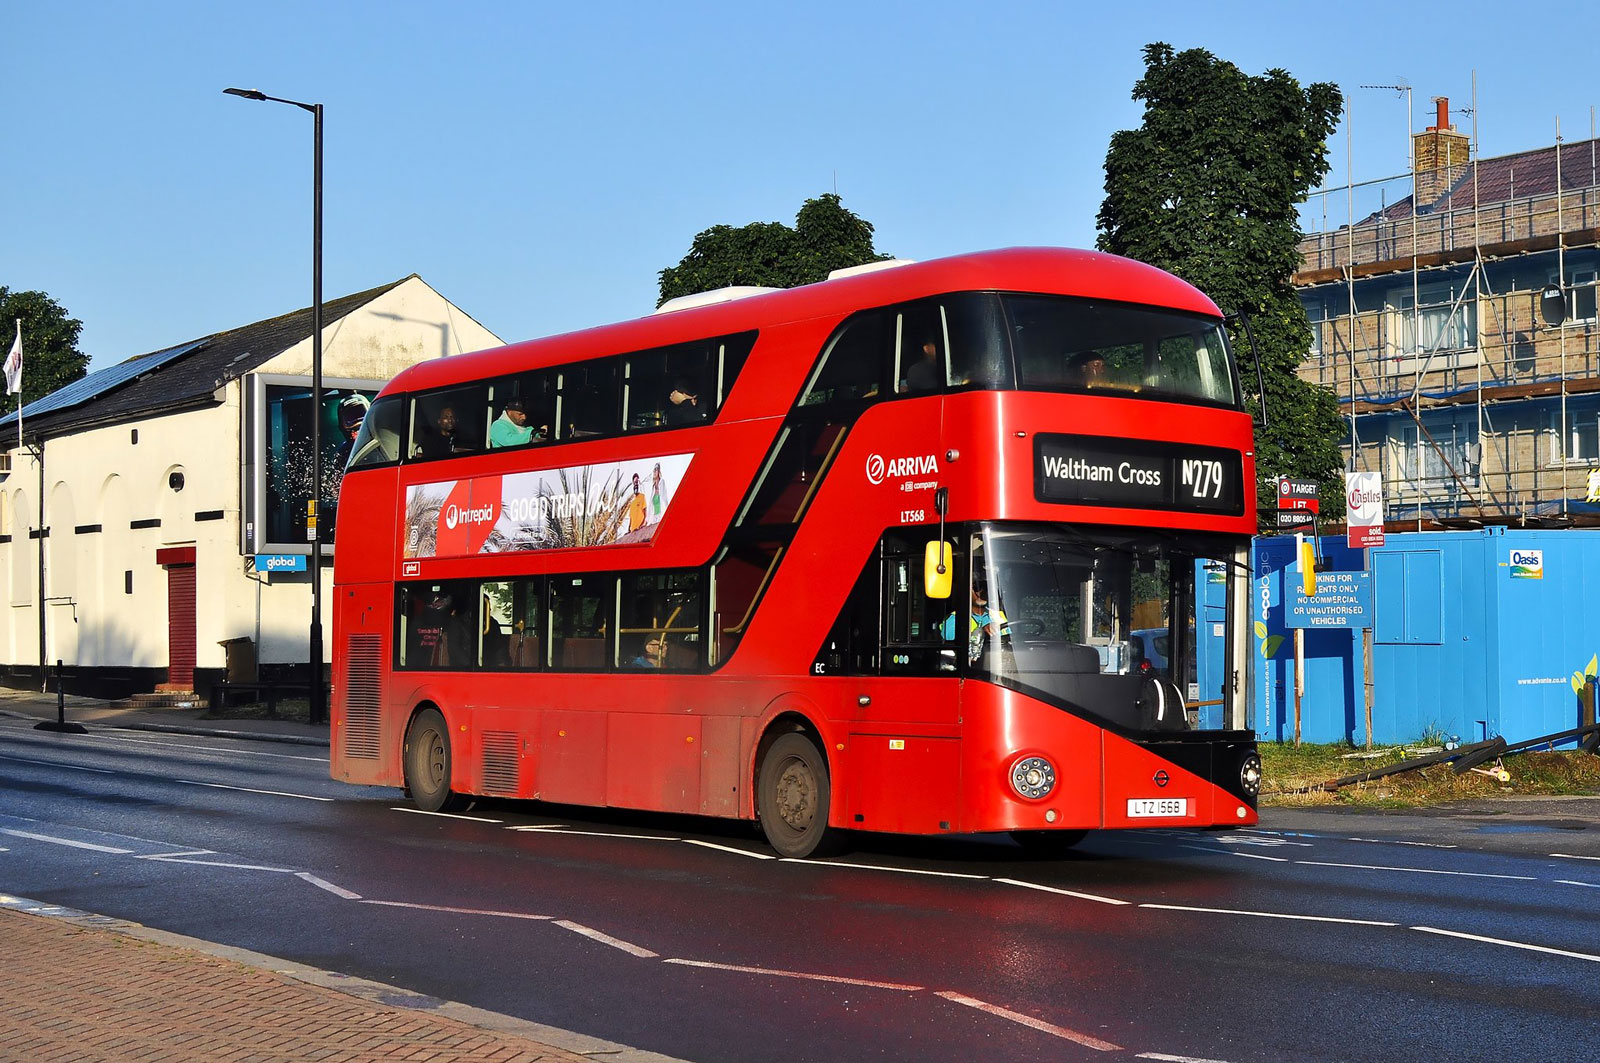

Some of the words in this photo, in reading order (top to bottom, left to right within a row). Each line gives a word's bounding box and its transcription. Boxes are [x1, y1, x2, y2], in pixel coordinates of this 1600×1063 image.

[886, 455, 938, 477] ARRIVA
[1043, 456, 1113, 482] Waltham
[1118, 462, 1161, 486] Cross
[1182, 459, 1222, 498] N279
[914, 482, 938, 490] company
[1291, 484, 1316, 494] TARGET
[511, 496, 548, 521] GOOD
[551, 491, 584, 519] TRIPS
[1348, 489, 1381, 510] Castles
[459, 504, 493, 525] Intrepid
[901, 510, 924, 523] LT568
[266, 556, 296, 569] global
[1513, 552, 1539, 565] Oasis
[1259, 551, 1272, 620] ecologic
[1339, 585, 1359, 593] ONLY
[1310, 596, 1359, 604] COMMERCIAL
[1293, 607, 1304, 615] OR
[1306, 606, 1363, 614] UNAUTHORISED
[1310, 617, 1347, 625] VEHICLES
[815, 663, 825, 673] EC
